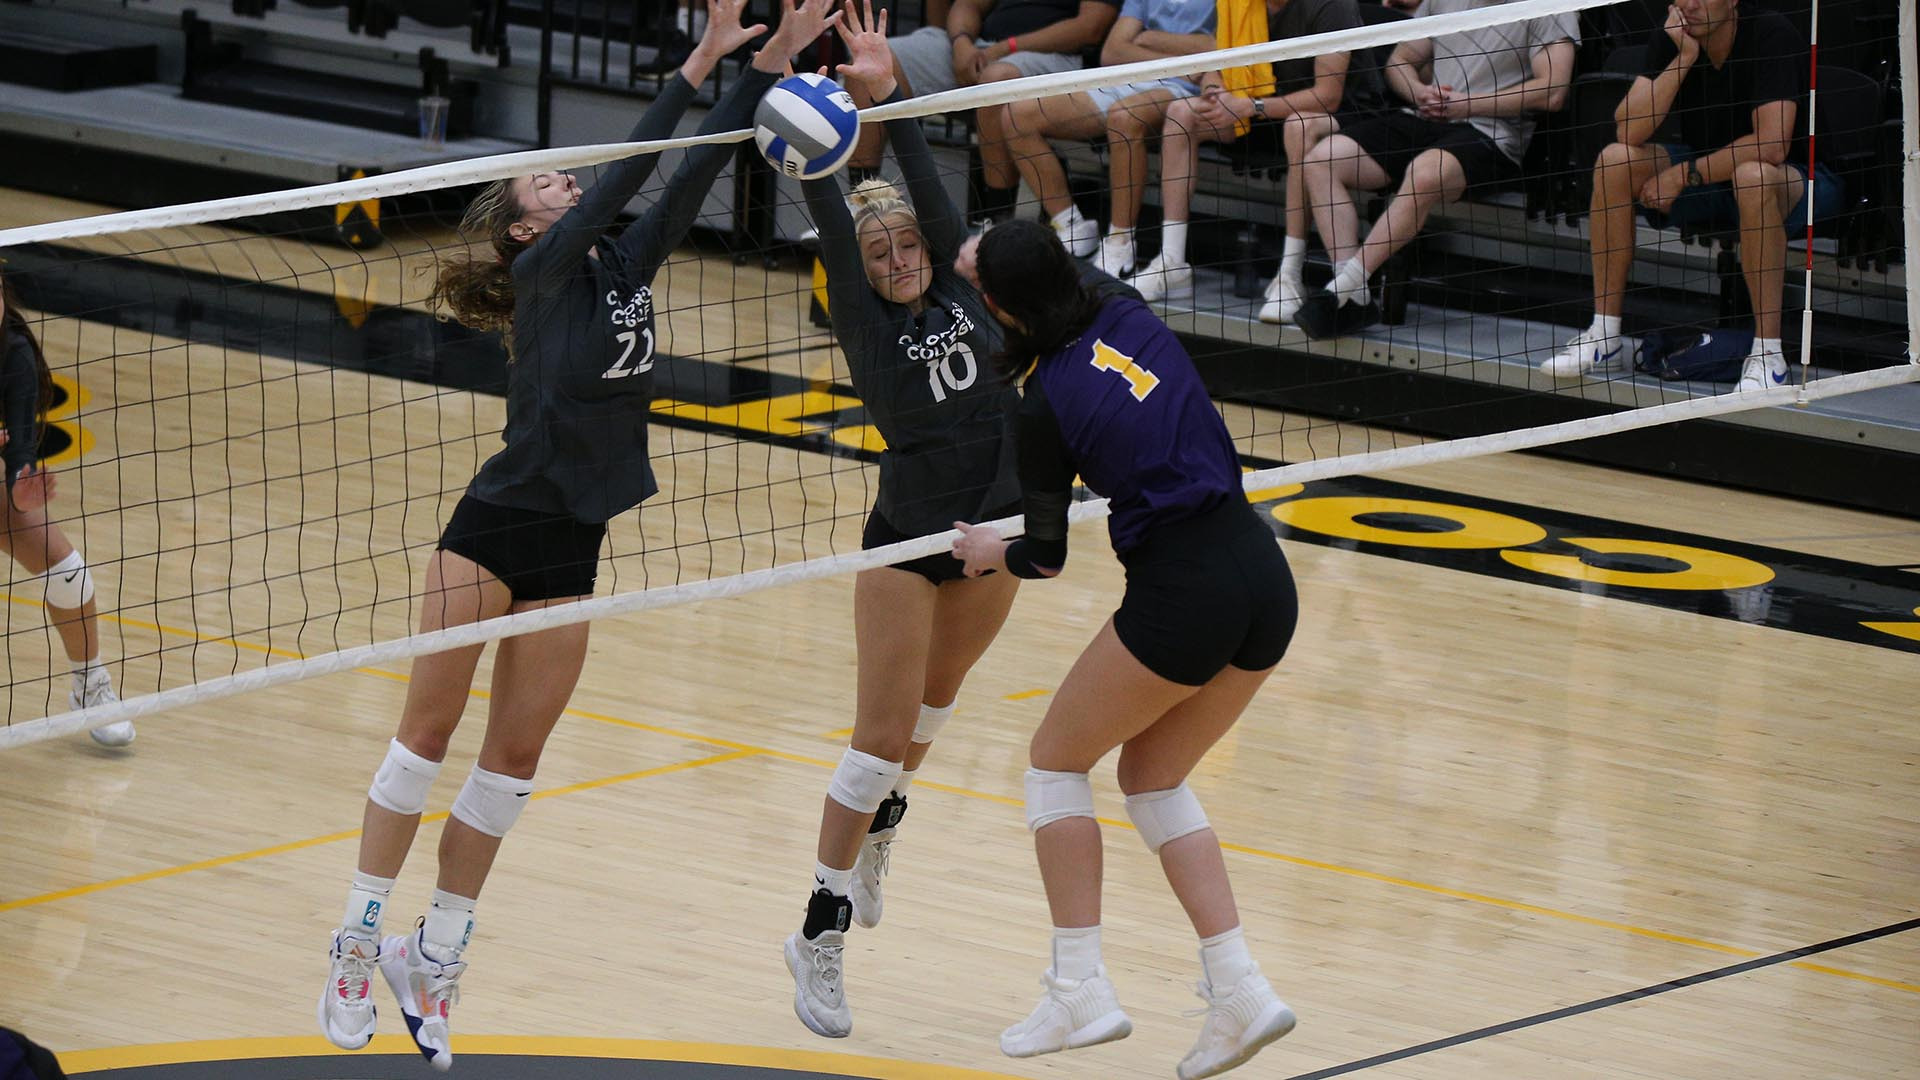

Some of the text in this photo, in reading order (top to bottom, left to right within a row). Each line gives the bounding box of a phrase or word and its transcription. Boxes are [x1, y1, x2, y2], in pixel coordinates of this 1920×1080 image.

[601, 327, 655, 379] 22
[926, 341, 978, 403] 10
[1090, 338, 1160, 402] 1
